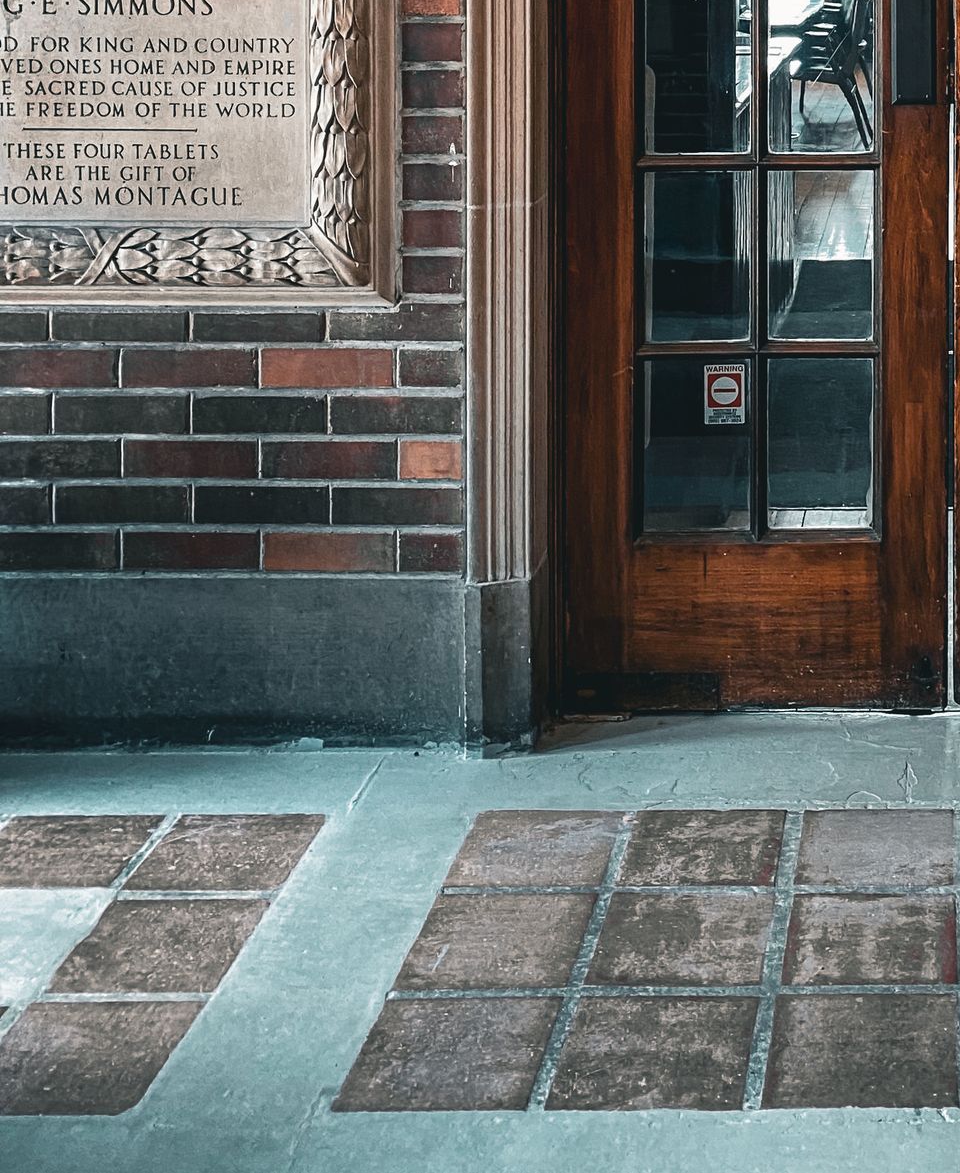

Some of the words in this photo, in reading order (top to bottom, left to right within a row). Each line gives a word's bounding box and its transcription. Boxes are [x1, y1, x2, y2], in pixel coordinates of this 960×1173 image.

[30, 37, 69, 52] FOR
[80, 37, 134, 53] KING
[143, 38, 187, 53] AND
[195, 38, 294, 54] COUNTRY
[50, 59, 101, 74] ONES
[110, 59, 164, 75] HOME
[172, 60, 215, 75] AND
[224, 60, 295, 75] EMPIRE
[25, 81, 105, 96] SACRED
[112, 81, 172, 96] CAUSE
[181, 81, 206, 96] OF
[213, 82, 295, 97] JUSTICE
[26, 102, 125, 117] FREEDOM
[135, 103, 161, 117] OF
[169, 103, 207, 117] THE
[216, 103, 295, 118] WORLD
[3, 144, 65, 159] THESE
[74, 144, 124, 159] FOUR
[132, 144, 219, 159] TABLETS
[25, 166, 64, 180] ARE
[75, 166, 110, 180] THE
[120, 166, 164, 181] GIFT
[172, 166, 196, 181] OF
[94, 186, 242, 206] MONTAGUE
